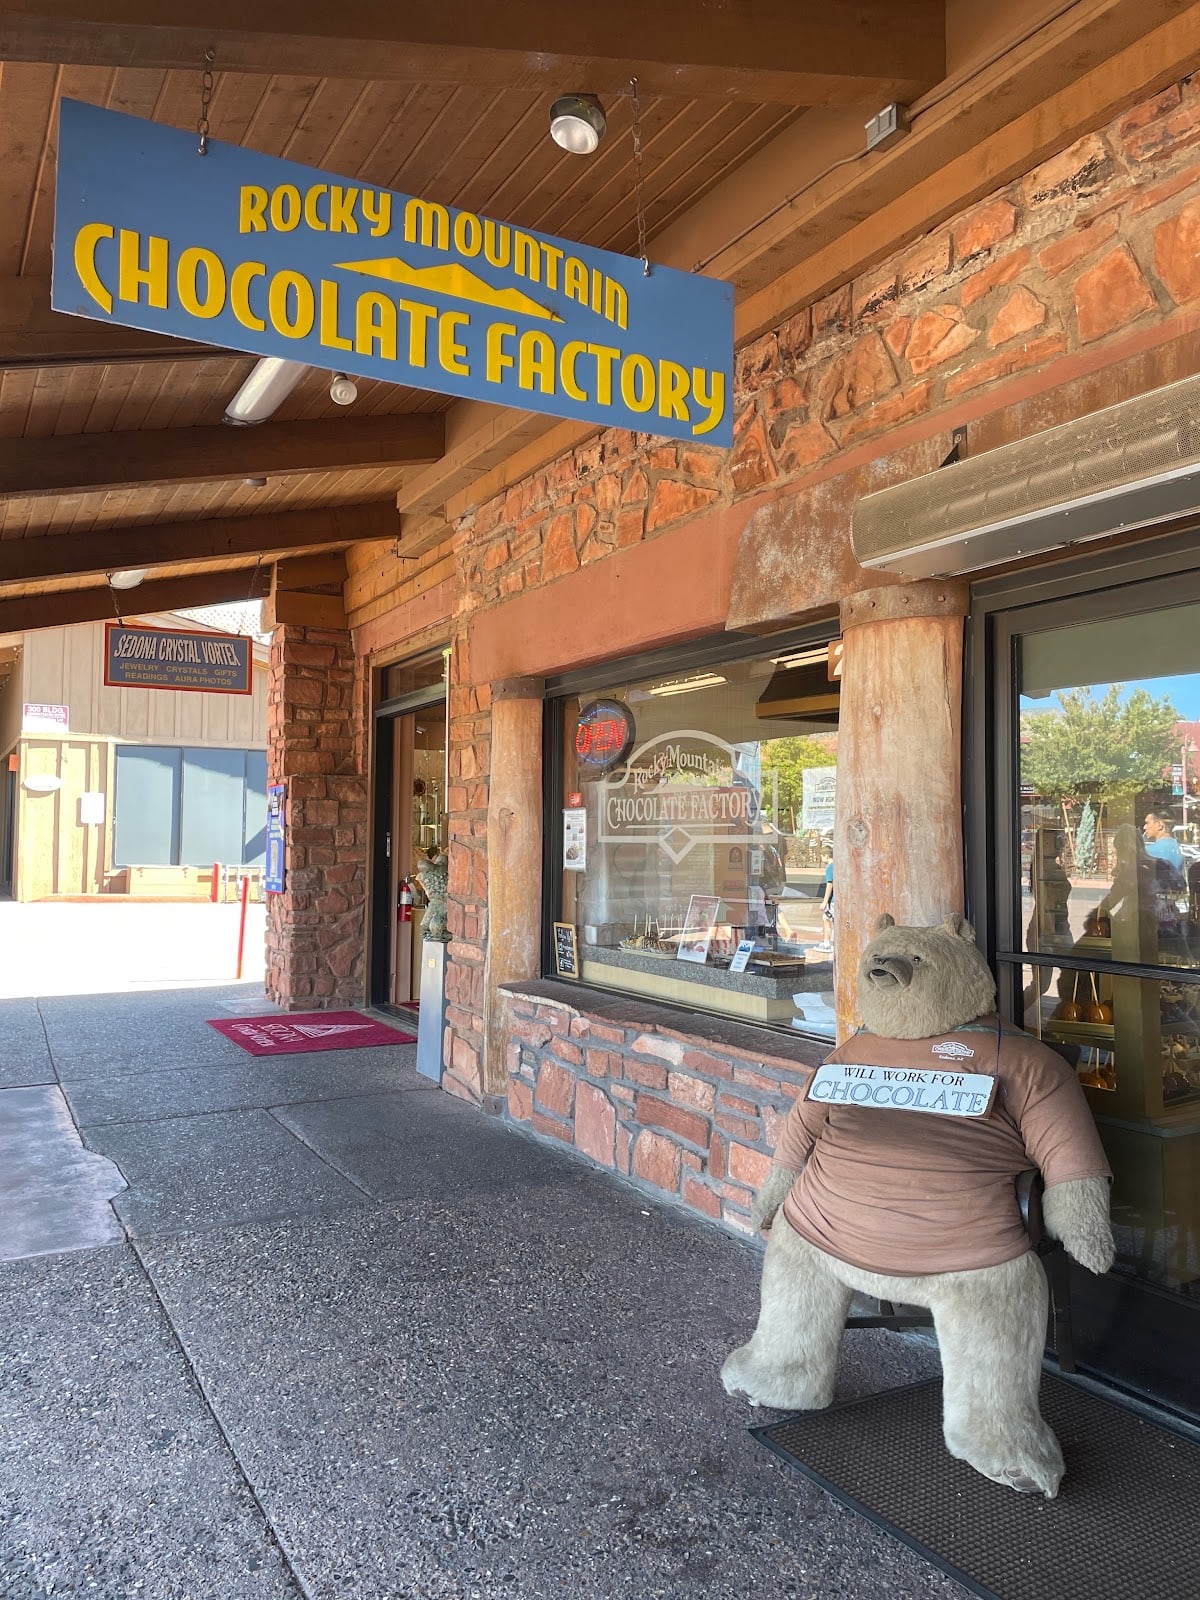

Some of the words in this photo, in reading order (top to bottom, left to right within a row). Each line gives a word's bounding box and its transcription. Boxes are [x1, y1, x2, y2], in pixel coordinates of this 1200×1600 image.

[238, 183, 392, 238] ROCKY
[403, 196, 629, 331] MOUNTAIN
[73, 222, 471, 378] CHOCOLATE
[485, 321, 726, 436] FACTORY
[113, 633, 157, 660] SEDONA
[158, 638, 202, 664] CRYSTAL
[201, 640, 242, 667] VORTEX
[119, 662, 160, 671] JEWELRY
[166, 665, 208, 675] CRYSTALS
[214, 669, 238, 677] GIFTS
[125, 671, 169, 681] READINGS
[174, 675, 199, 683] AURA
[199, 676, 232, 686] PHOTOS
[575, 716, 626, 753] OPEN
[633, 752, 670, 794] Rocky
[606, 795, 686, 829] CHOCOLATE
[690, 788, 761, 826] FACTORY
[844, 1067, 876, 1080] WILL
[883, 1070, 928, 1084] WORK
[930, 1073, 965, 1087] FOR
[812, 1080, 987, 1114] CHOCOLATE
